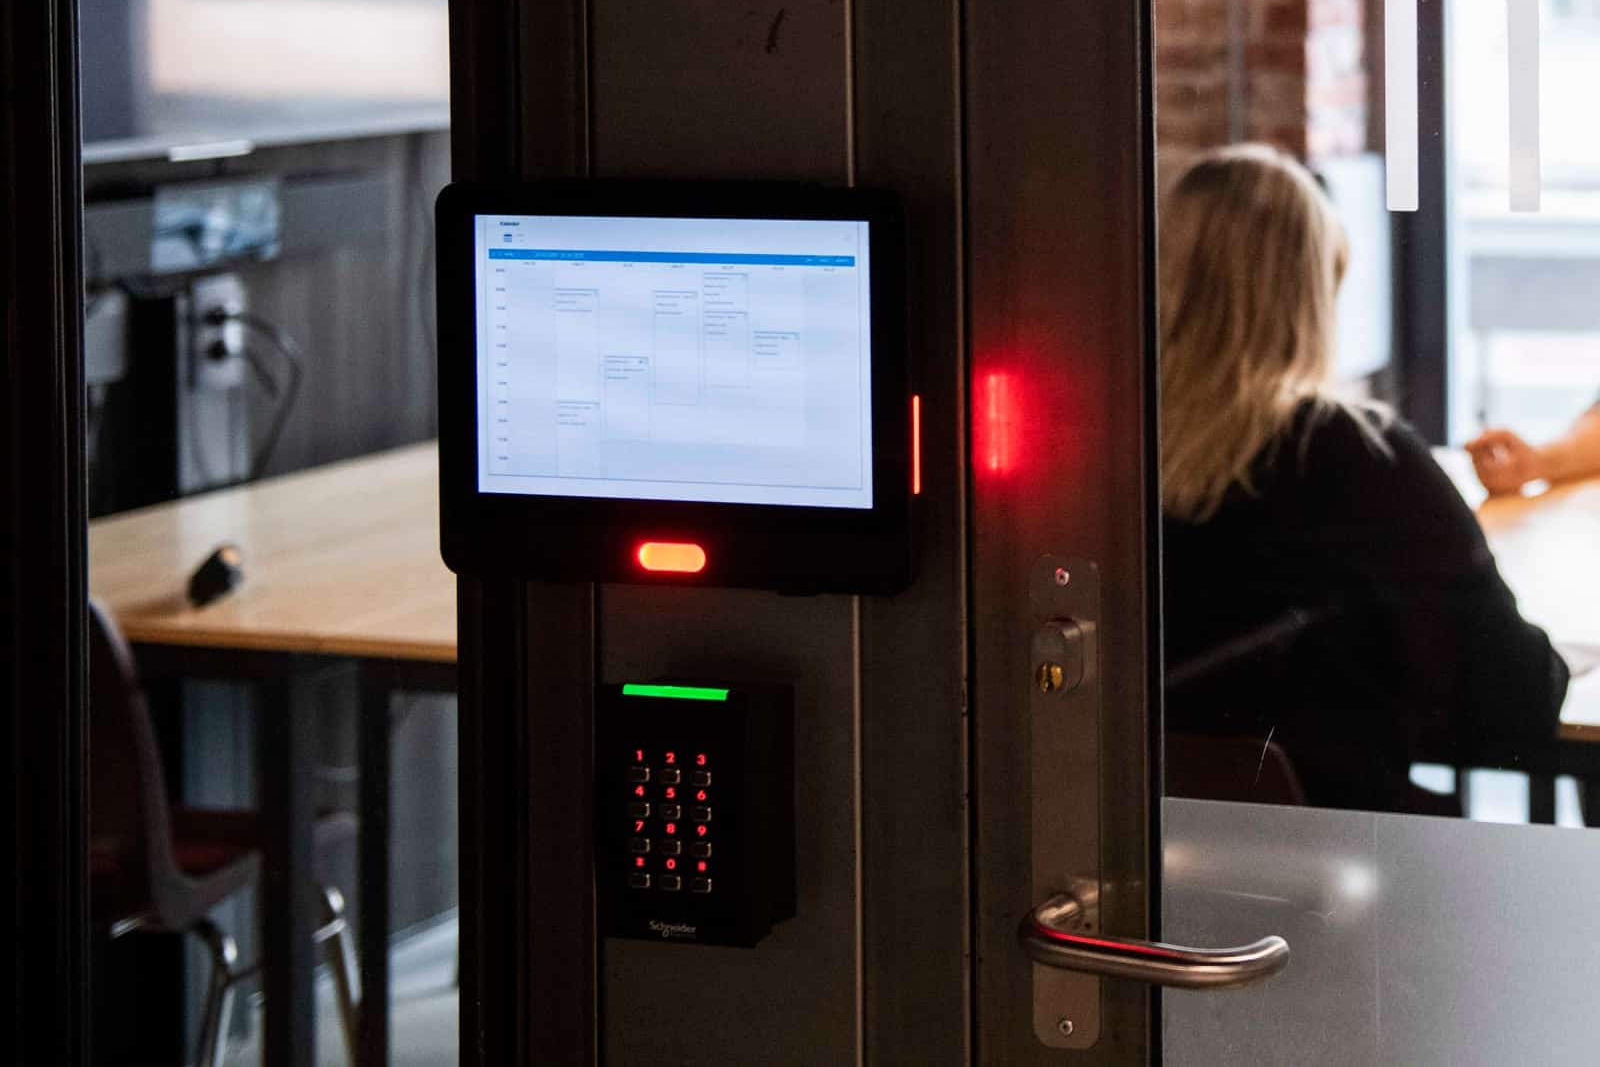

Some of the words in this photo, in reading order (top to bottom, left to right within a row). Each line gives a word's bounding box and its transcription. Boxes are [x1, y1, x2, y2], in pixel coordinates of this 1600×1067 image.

[635, 749, 643, 762] 1
[665, 752, 675, 764] 2
[696, 753, 706, 766] 3
[635, 785, 645, 797] 4
[665, 786, 676, 799] 5
[696, 789, 707, 801] 6
[635, 820, 645, 832] 7
[665, 822, 676, 835] 8
[696, 824, 707, 837] 9
[665, 857, 676, 870] 0
